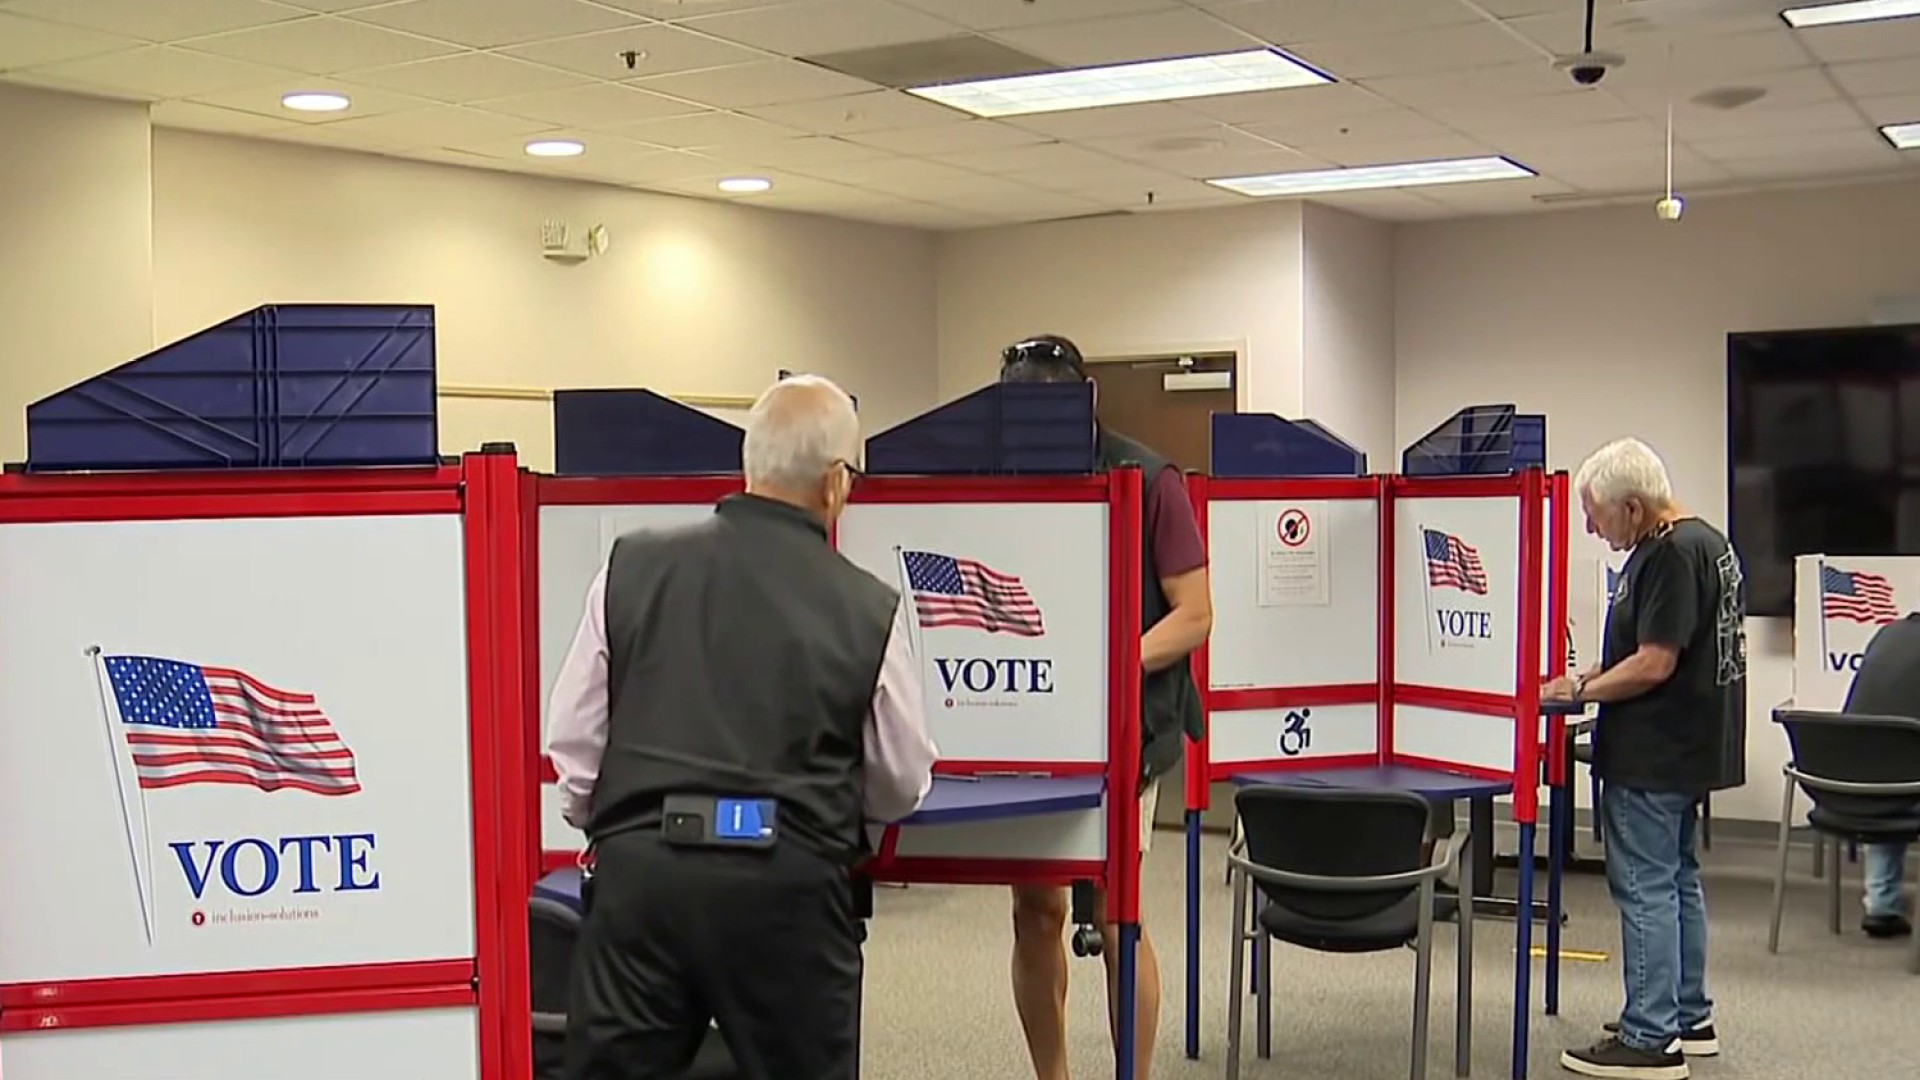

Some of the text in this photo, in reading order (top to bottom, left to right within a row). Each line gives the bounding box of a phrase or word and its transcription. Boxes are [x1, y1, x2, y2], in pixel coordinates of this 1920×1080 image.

[1437, 610, 1491, 638] VOTE
[933, 658, 1054, 693] VOTE
[168, 833, 381, 899] VOTE
